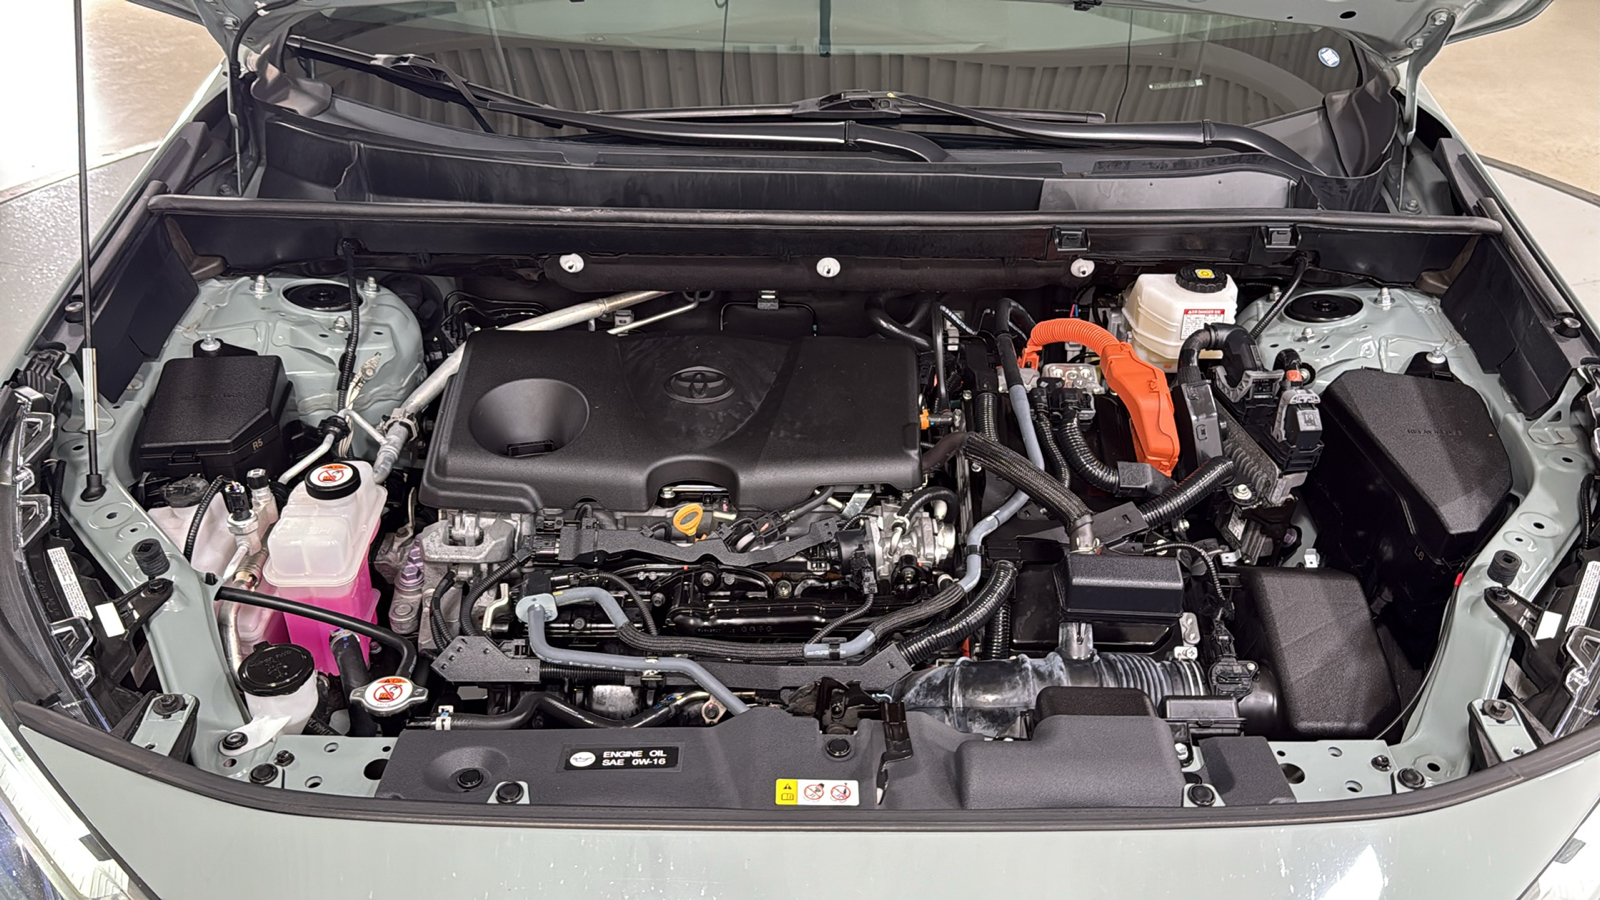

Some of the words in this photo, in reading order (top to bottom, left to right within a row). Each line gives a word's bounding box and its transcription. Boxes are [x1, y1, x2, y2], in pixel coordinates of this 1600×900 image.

[252, 438, 263, 450] R5
[603, 750, 643, 758] ENGINE
[632, 758, 666, 766] 0W-16
